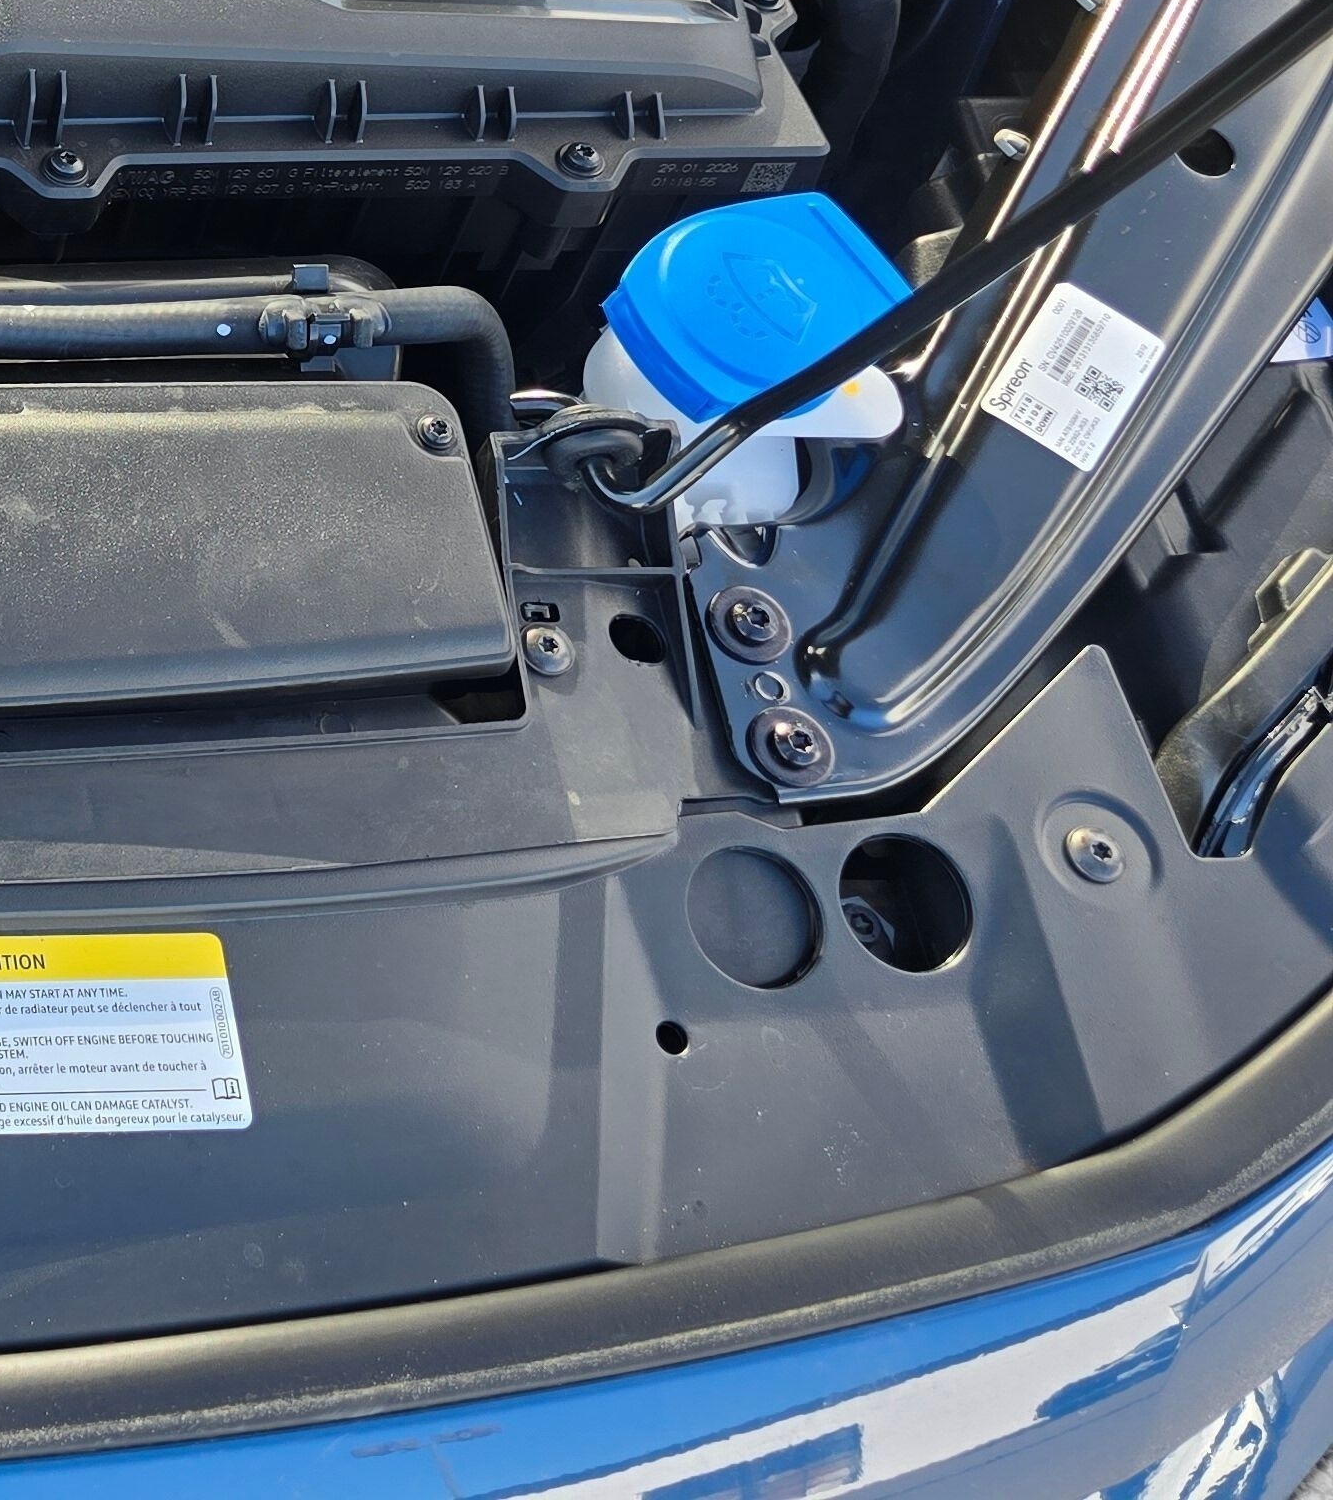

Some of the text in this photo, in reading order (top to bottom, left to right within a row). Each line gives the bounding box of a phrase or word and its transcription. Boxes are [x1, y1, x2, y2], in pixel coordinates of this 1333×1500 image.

[303, 167, 400, 178] Filterelement
[657, 163, 739, 174] 29.01.2026
[1014, 397, 1033, 420] THIS
[1024, 403, 1043, 426] SIDE
[1036, 409, 1054, 433] DOWN
[5, 989, 27, 1000] MAY
[28, 988, 60, 999] START
[62, 988, 75, 999] AT
[77, 987, 98, 998] ANY
[99, 987, 128, 998] TIME.
[4, 1003, 18, 1015] de
[20, 1003, 68, 1015] radiateur
[70, 1003, 96, 1016] peut
[97, 1004, 109, 1013] se
[111, 1001, 168, 1013] déclencher
[170, 1001, 177, 1012] à
[178, 1002, 202, 1012] tout
[215, 1003, 224, 1020] 002
[219, 1021, 227, 1038] 010
[12, 1035, 53, 1047] SWITCH
[54, 1035, 75, 1046] OFF
[77, 1034, 116, 1046] ENGINE
[118, 1033, 158, 1045] BEFORE
[160, 1032, 214, 1044] TOUCHING
[222, 1040, 231, 1055] 701
[18, 1063, 54, 1075] arrêter
[56, 1062, 66, 1074] le
[68, 1063, 108, 1074] moteur
[110, 1062, 140, 1073] avant
[142, 1061, 156, 1072] de
[157, 1060, 198, 1072] toucher
[200, 1060, 207, 1071] à
[8, 1101, 49, 1113] ENGINE
[50, 1101, 69, 1112] OIL
[70, 1100, 92, 1111] CAN
[94, 1099, 139, 1111] DAMAGE
[141, 1098, 193, 1110] CATALYST.
[13, 1114, 54, 1127] excessif
[57, 1114, 93, 1126] d'huile
[94, 1113, 150, 1127] dangereux
[152, 1115, 176, 1127] pour
[178, 1112, 188, 1123] le
[190, 1112, 246, 1125] catalyseur.
